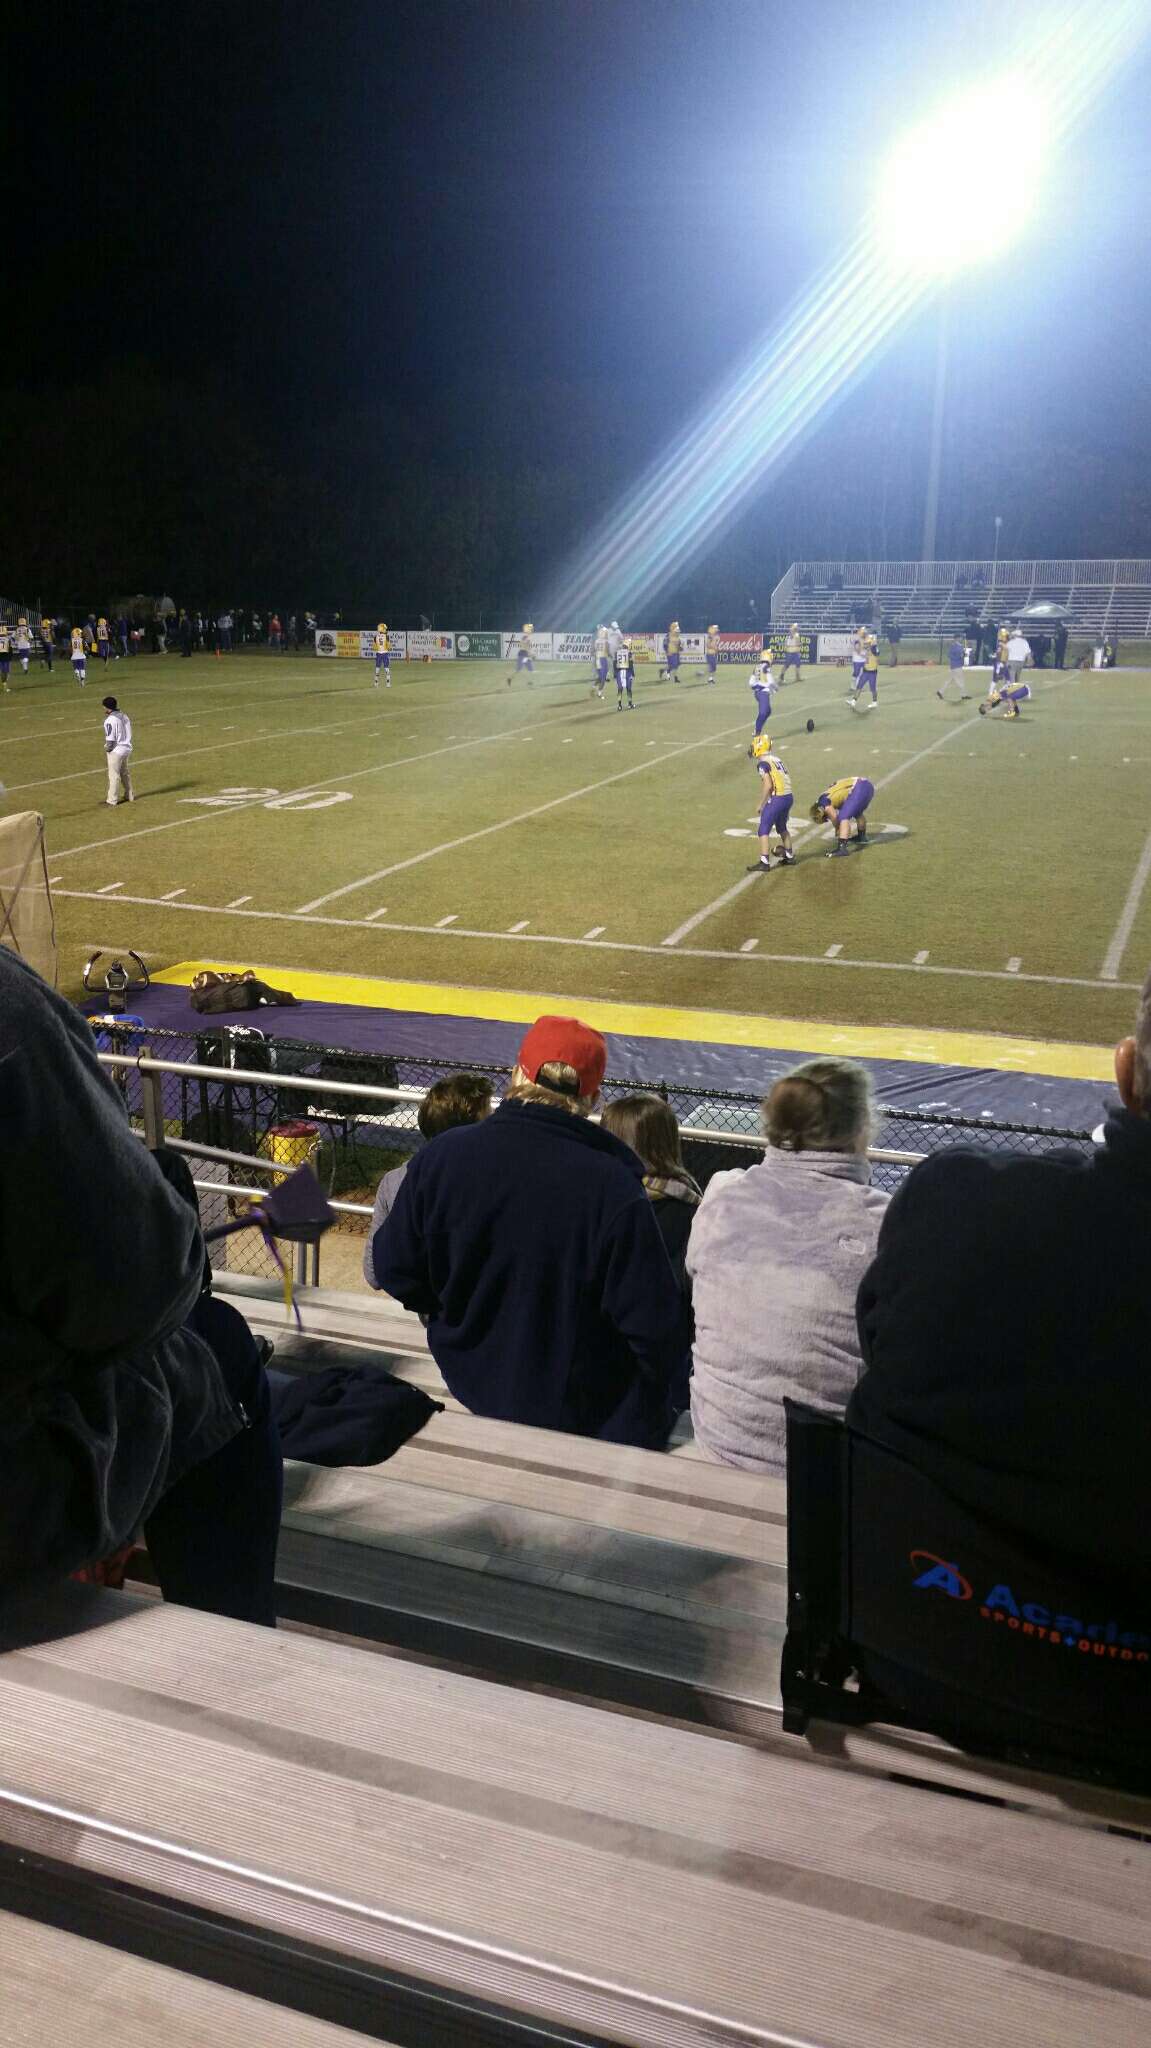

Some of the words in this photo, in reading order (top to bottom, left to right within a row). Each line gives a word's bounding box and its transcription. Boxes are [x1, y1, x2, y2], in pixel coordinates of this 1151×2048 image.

[565, 635, 592, 643] TEAM
[717, 634, 762, 651] eacock's
[769, 636, 810, 644] ADVED
[558, 643, 593, 653] SPORT
[769, 645, 810, 653] PLUNG
[616, 654, 627, 664] 27
[730, 652, 761, 663] SALVAGE
